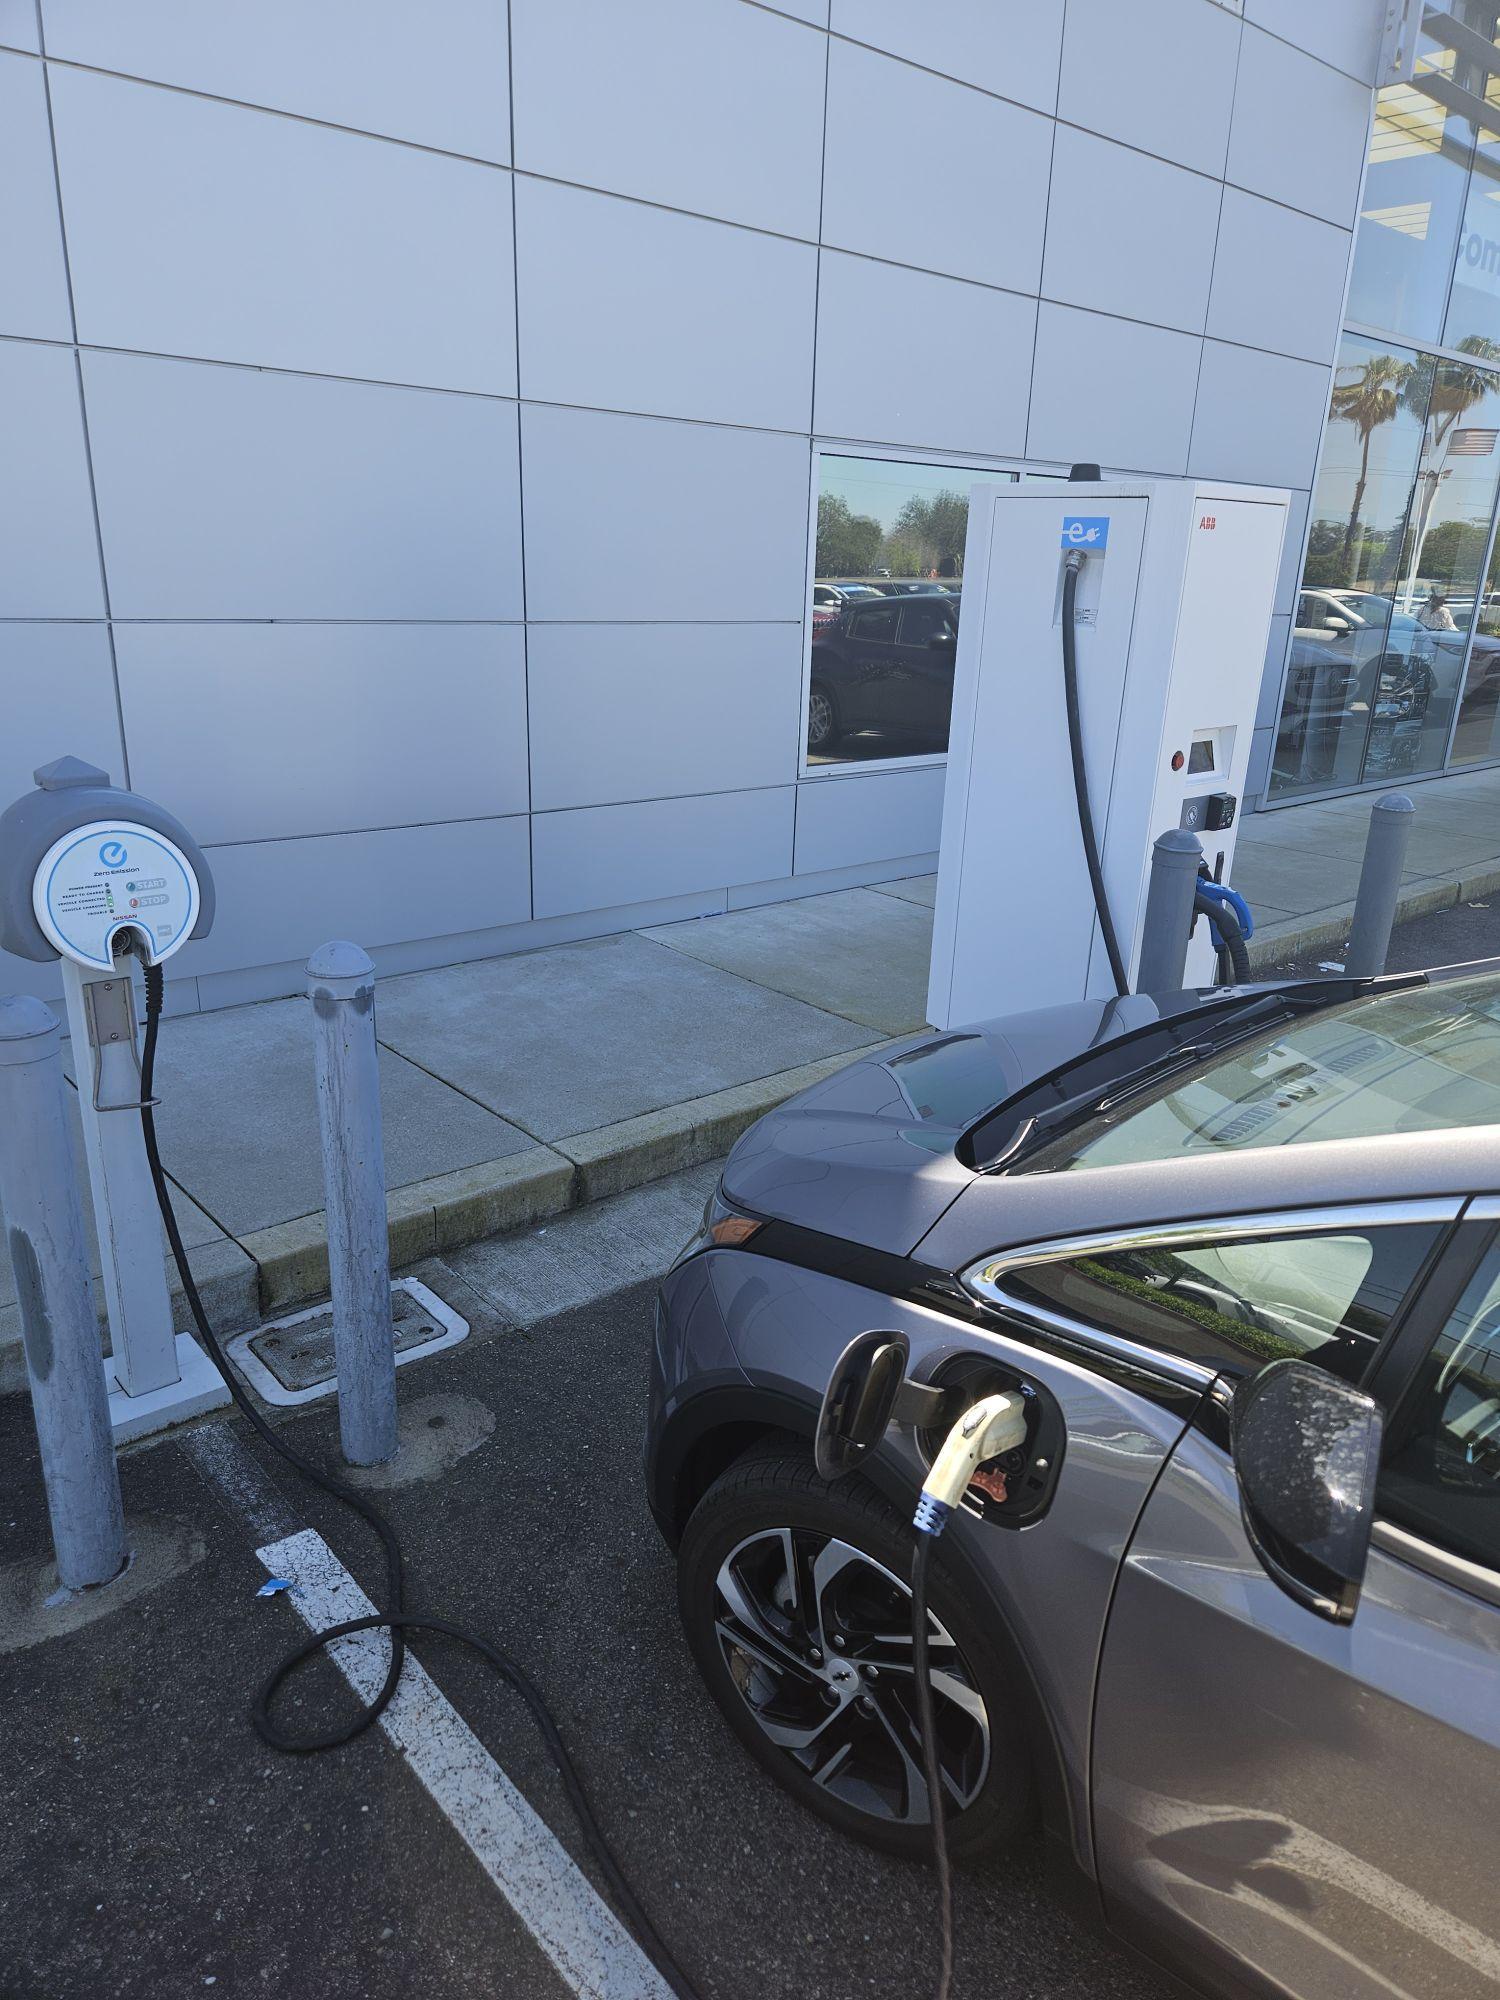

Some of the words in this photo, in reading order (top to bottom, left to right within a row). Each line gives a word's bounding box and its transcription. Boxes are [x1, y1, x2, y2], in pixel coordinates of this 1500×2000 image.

[1199, 516, 1216, 530] ABB
[137, 880, 165, 890] START
[141, 895, 166, 906] STOP
